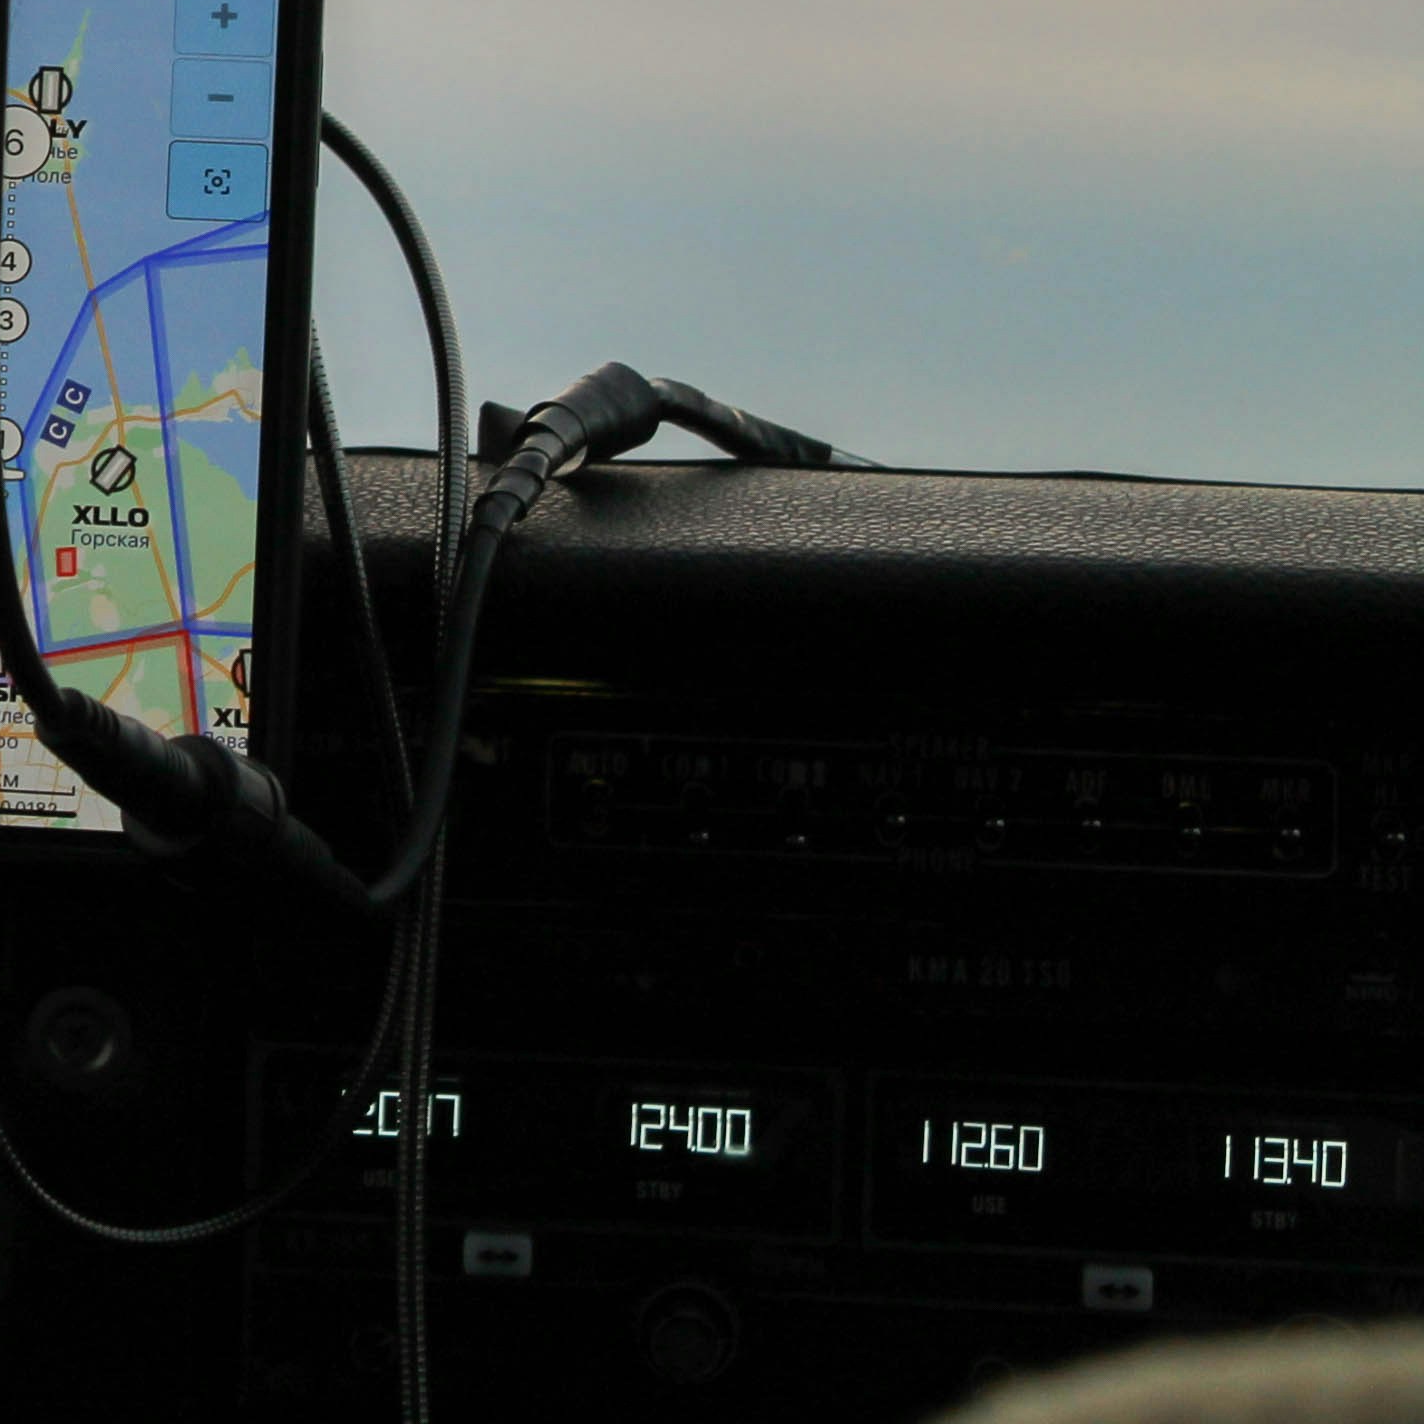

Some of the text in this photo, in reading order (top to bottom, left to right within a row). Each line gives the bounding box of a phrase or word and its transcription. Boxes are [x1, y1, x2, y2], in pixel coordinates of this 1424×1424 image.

[5, 129, 25, 156] 6
[1, 251, 17, 272] 4
[0, 310, 14, 331] 3
[72, 504, 150, 527] XLLO
[71, 529, 150, 549] Горская
[971, 1193, 1009, 1215] USE
